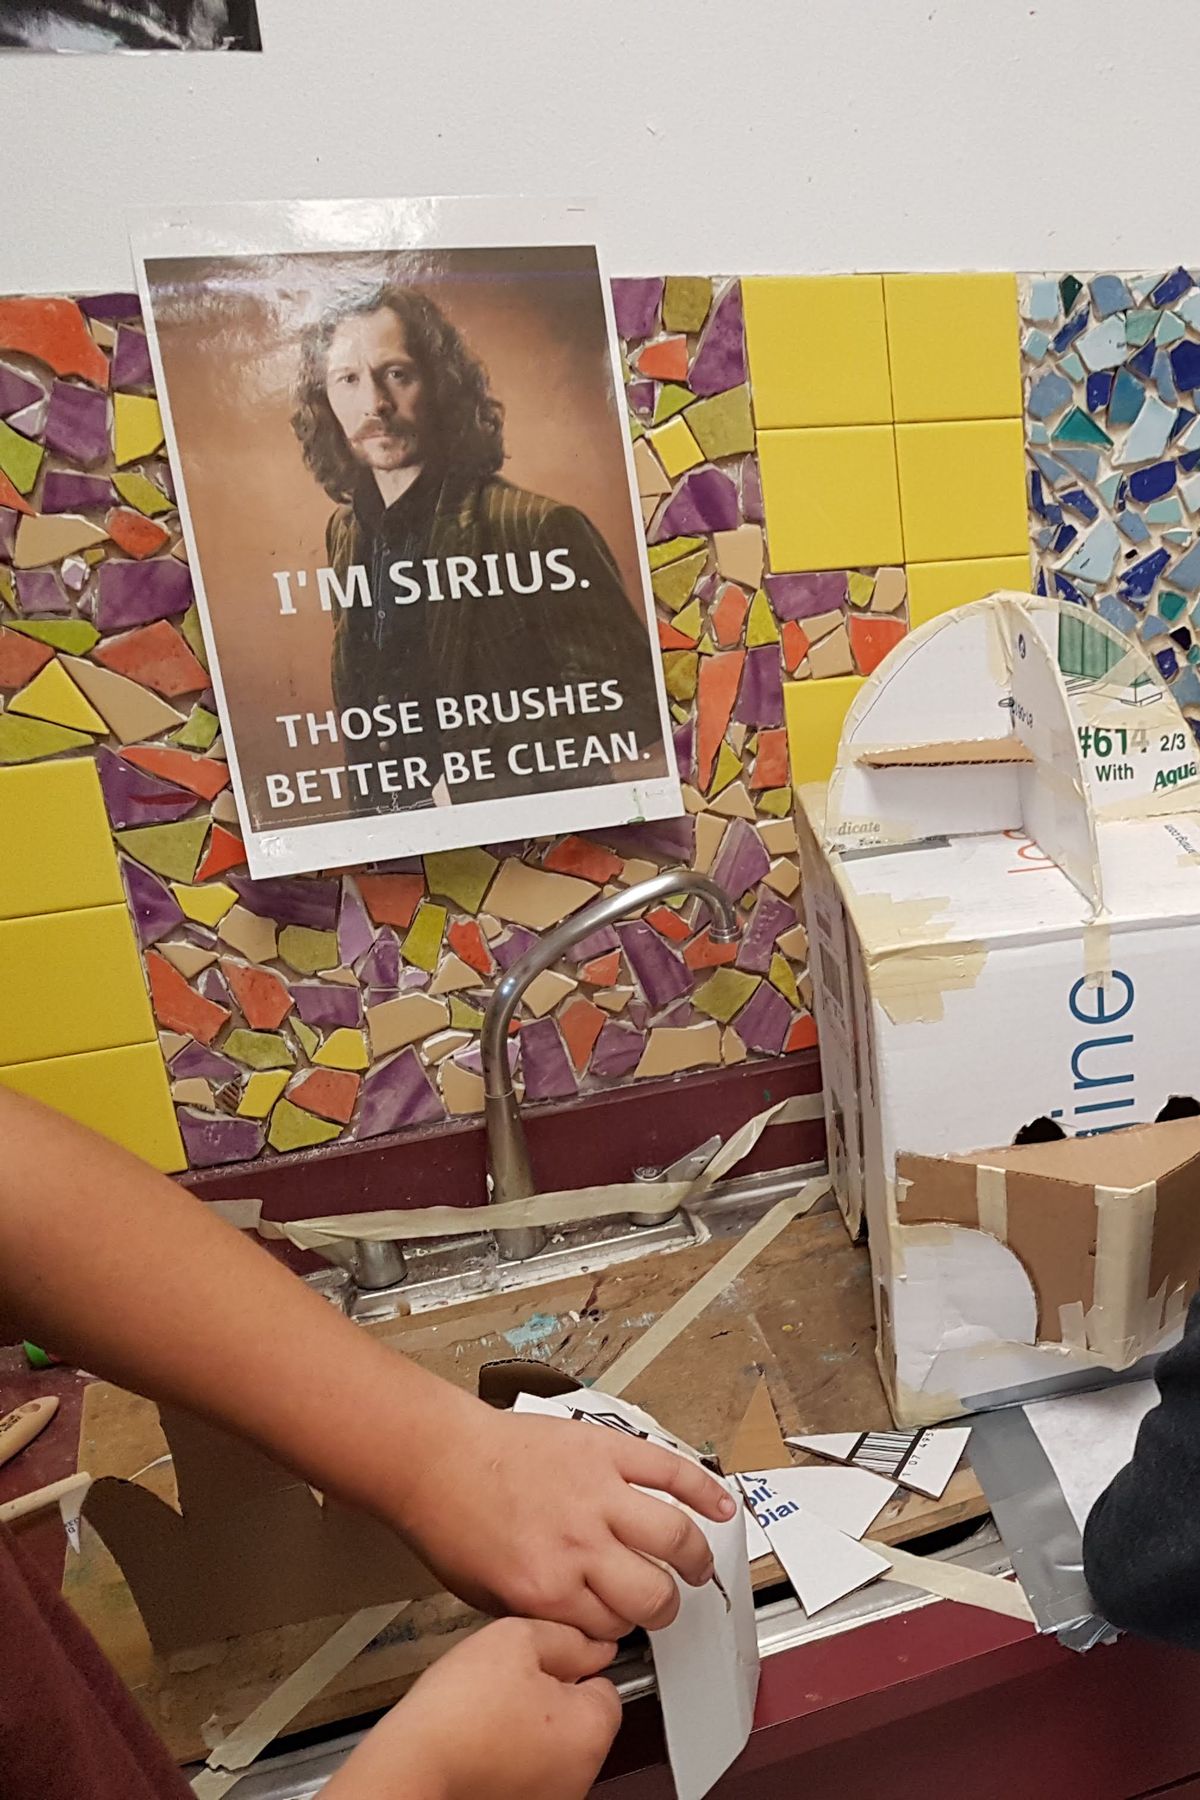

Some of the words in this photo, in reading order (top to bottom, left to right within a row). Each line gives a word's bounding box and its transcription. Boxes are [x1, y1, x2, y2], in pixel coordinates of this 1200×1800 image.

[273, 563, 373, 615] I'M
[389, 547, 591, 606] SIRIUS.
[276, 700, 424, 748] THOSE
[436, 678, 625, 730] BRUSHES
[1160, 733, 1186, 752] 2/3
[264, 754, 431, 808] BETTER
[443, 747, 496, 785] BE
[507, 730, 651, 776] CLEAN.
[1095, 762, 1134, 782] With
[1153, 761, 1197, 792] Aqua
[1052, 969, 1135, 1137] ine
